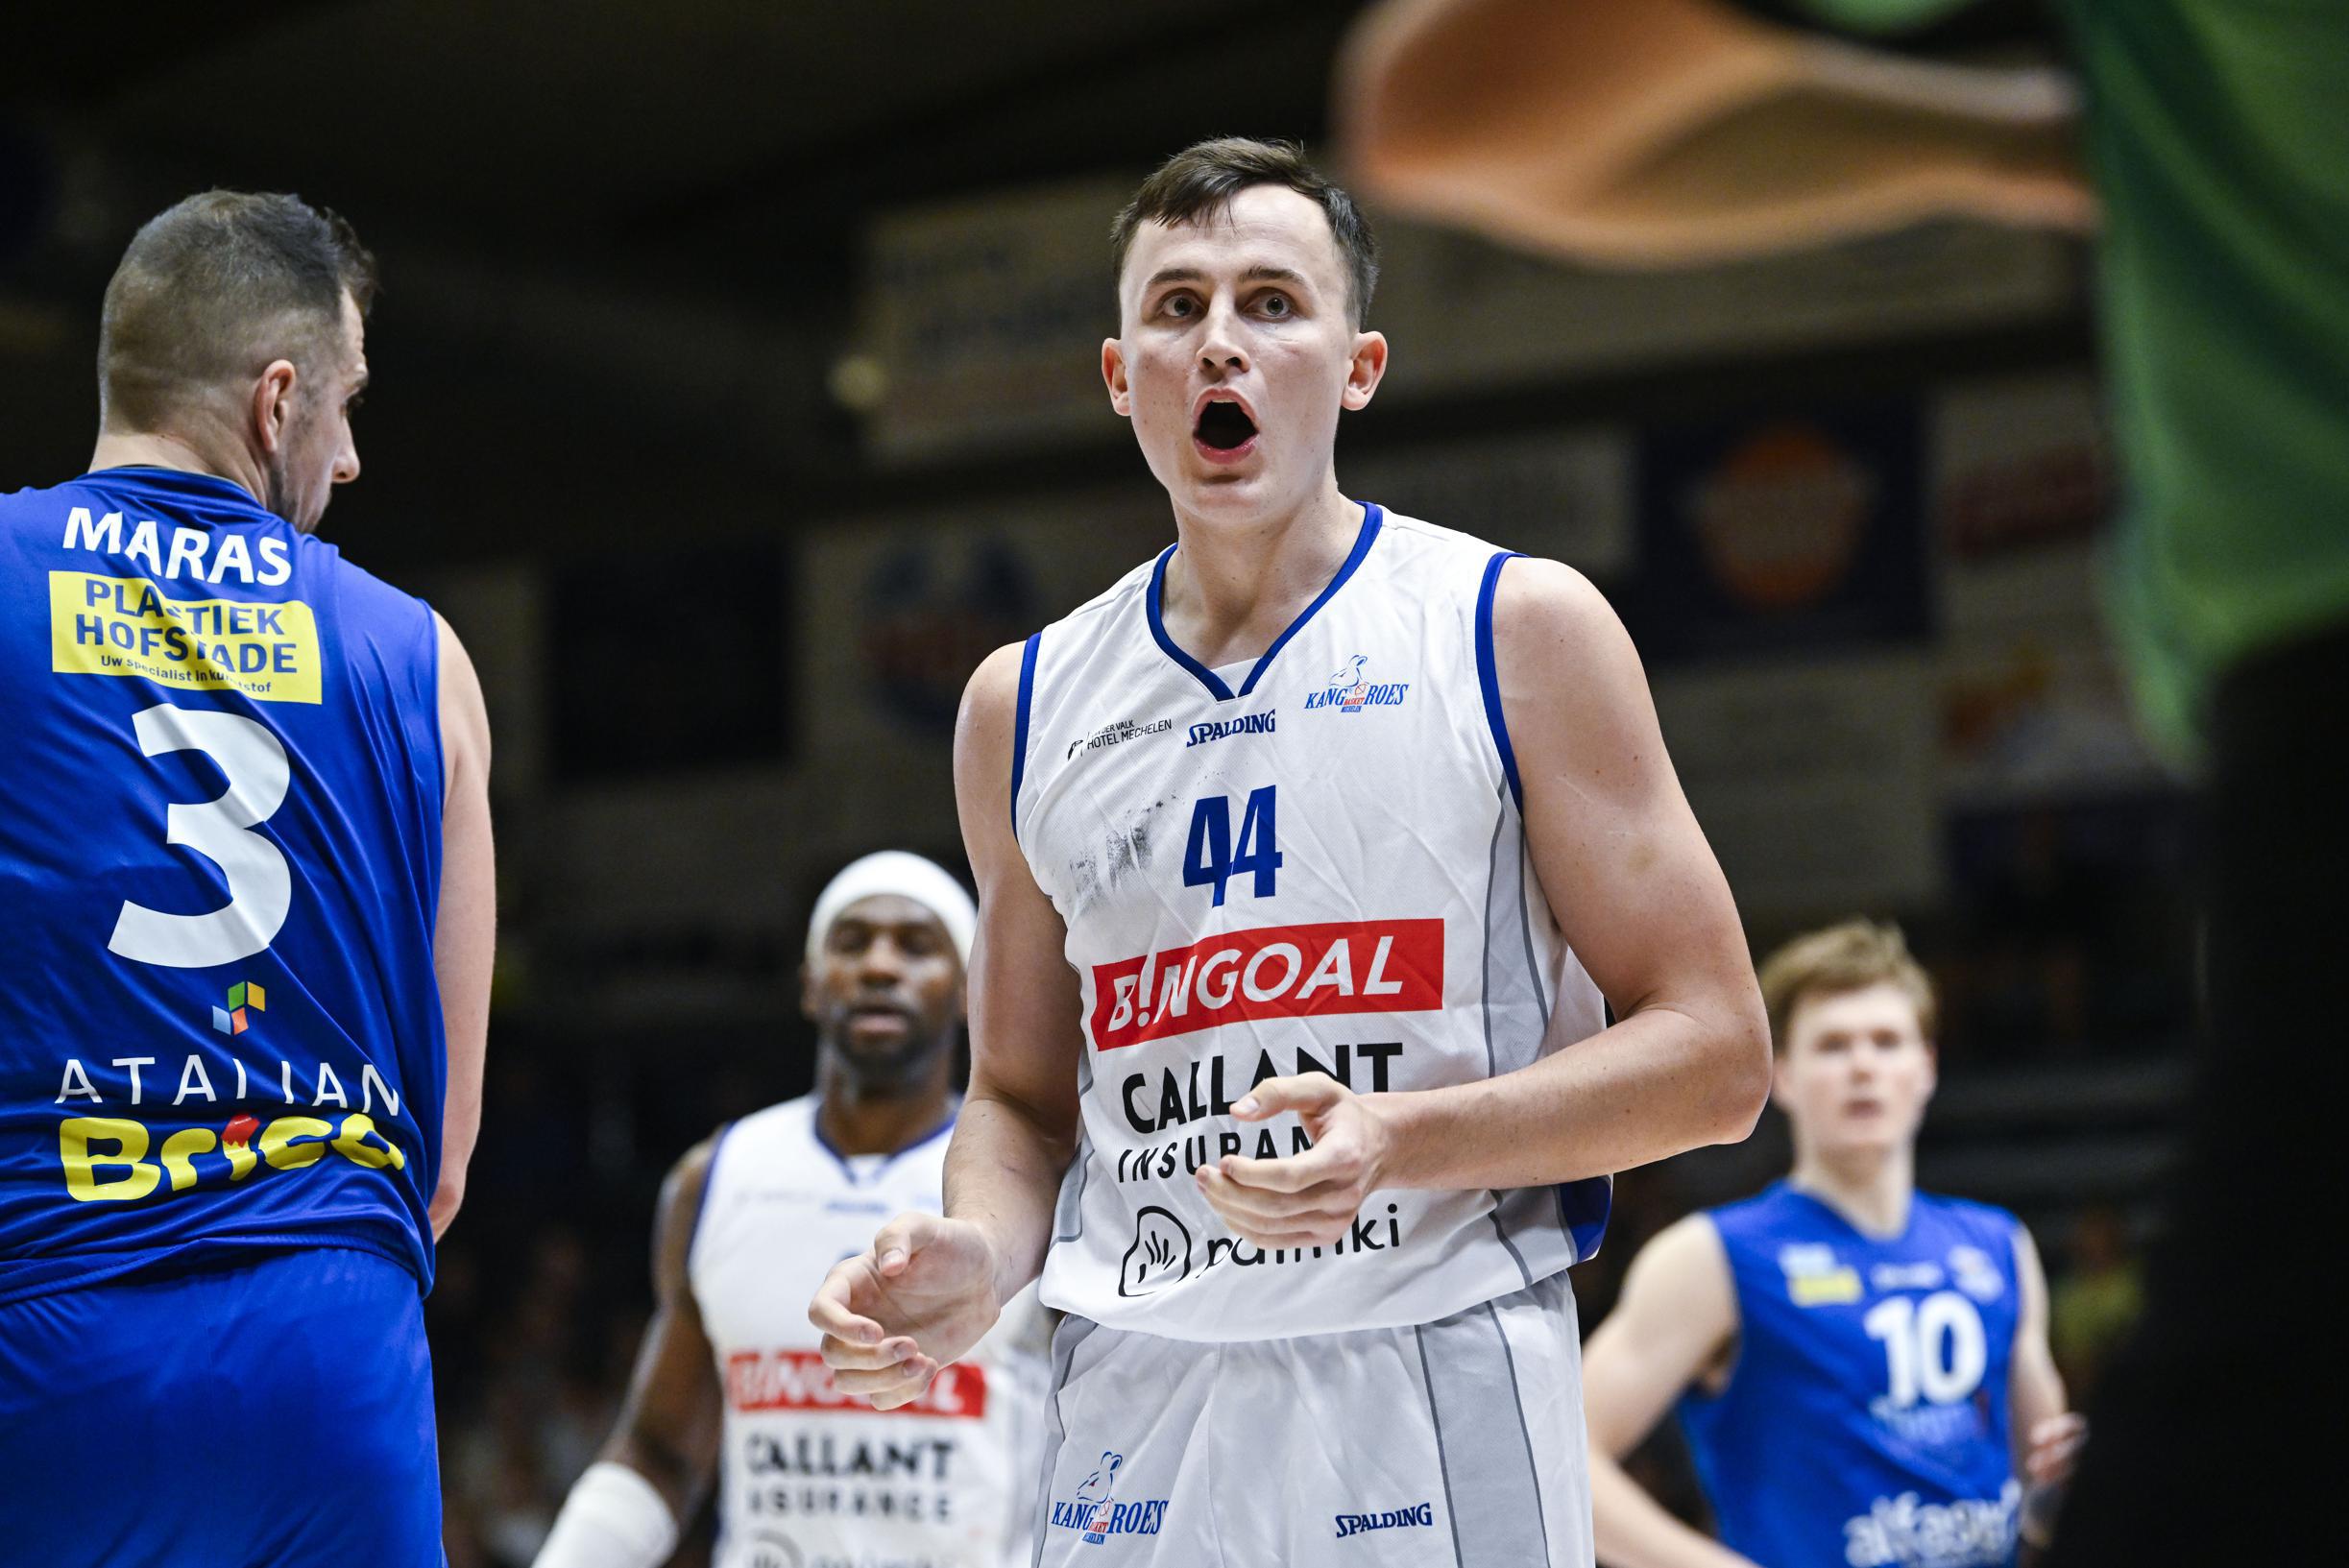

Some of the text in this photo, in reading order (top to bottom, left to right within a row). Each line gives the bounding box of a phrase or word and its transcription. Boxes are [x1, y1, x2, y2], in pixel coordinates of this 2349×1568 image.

[62, 507, 292, 586] MARAS
[101, 655, 271, 692] Uw specialist in kutstof
[1087, 734, 1120, 750] HOTEL
[1121, 718, 1173, 742] MECHELEN
[1116, 719, 1134, 730] VALK
[1186, 709, 1275, 747] SPALDING
[107, 703, 292, 969] 3
[1182, 784, 1283, 907] 44
[1107, 935, 1404, 1033] B!NGOAL
[1118, 1126, 1314, 1183] INSURAN
[1863, 1291, 1987, 1410] 10
[1336, 1503, 1432, 1537] SPALDING
